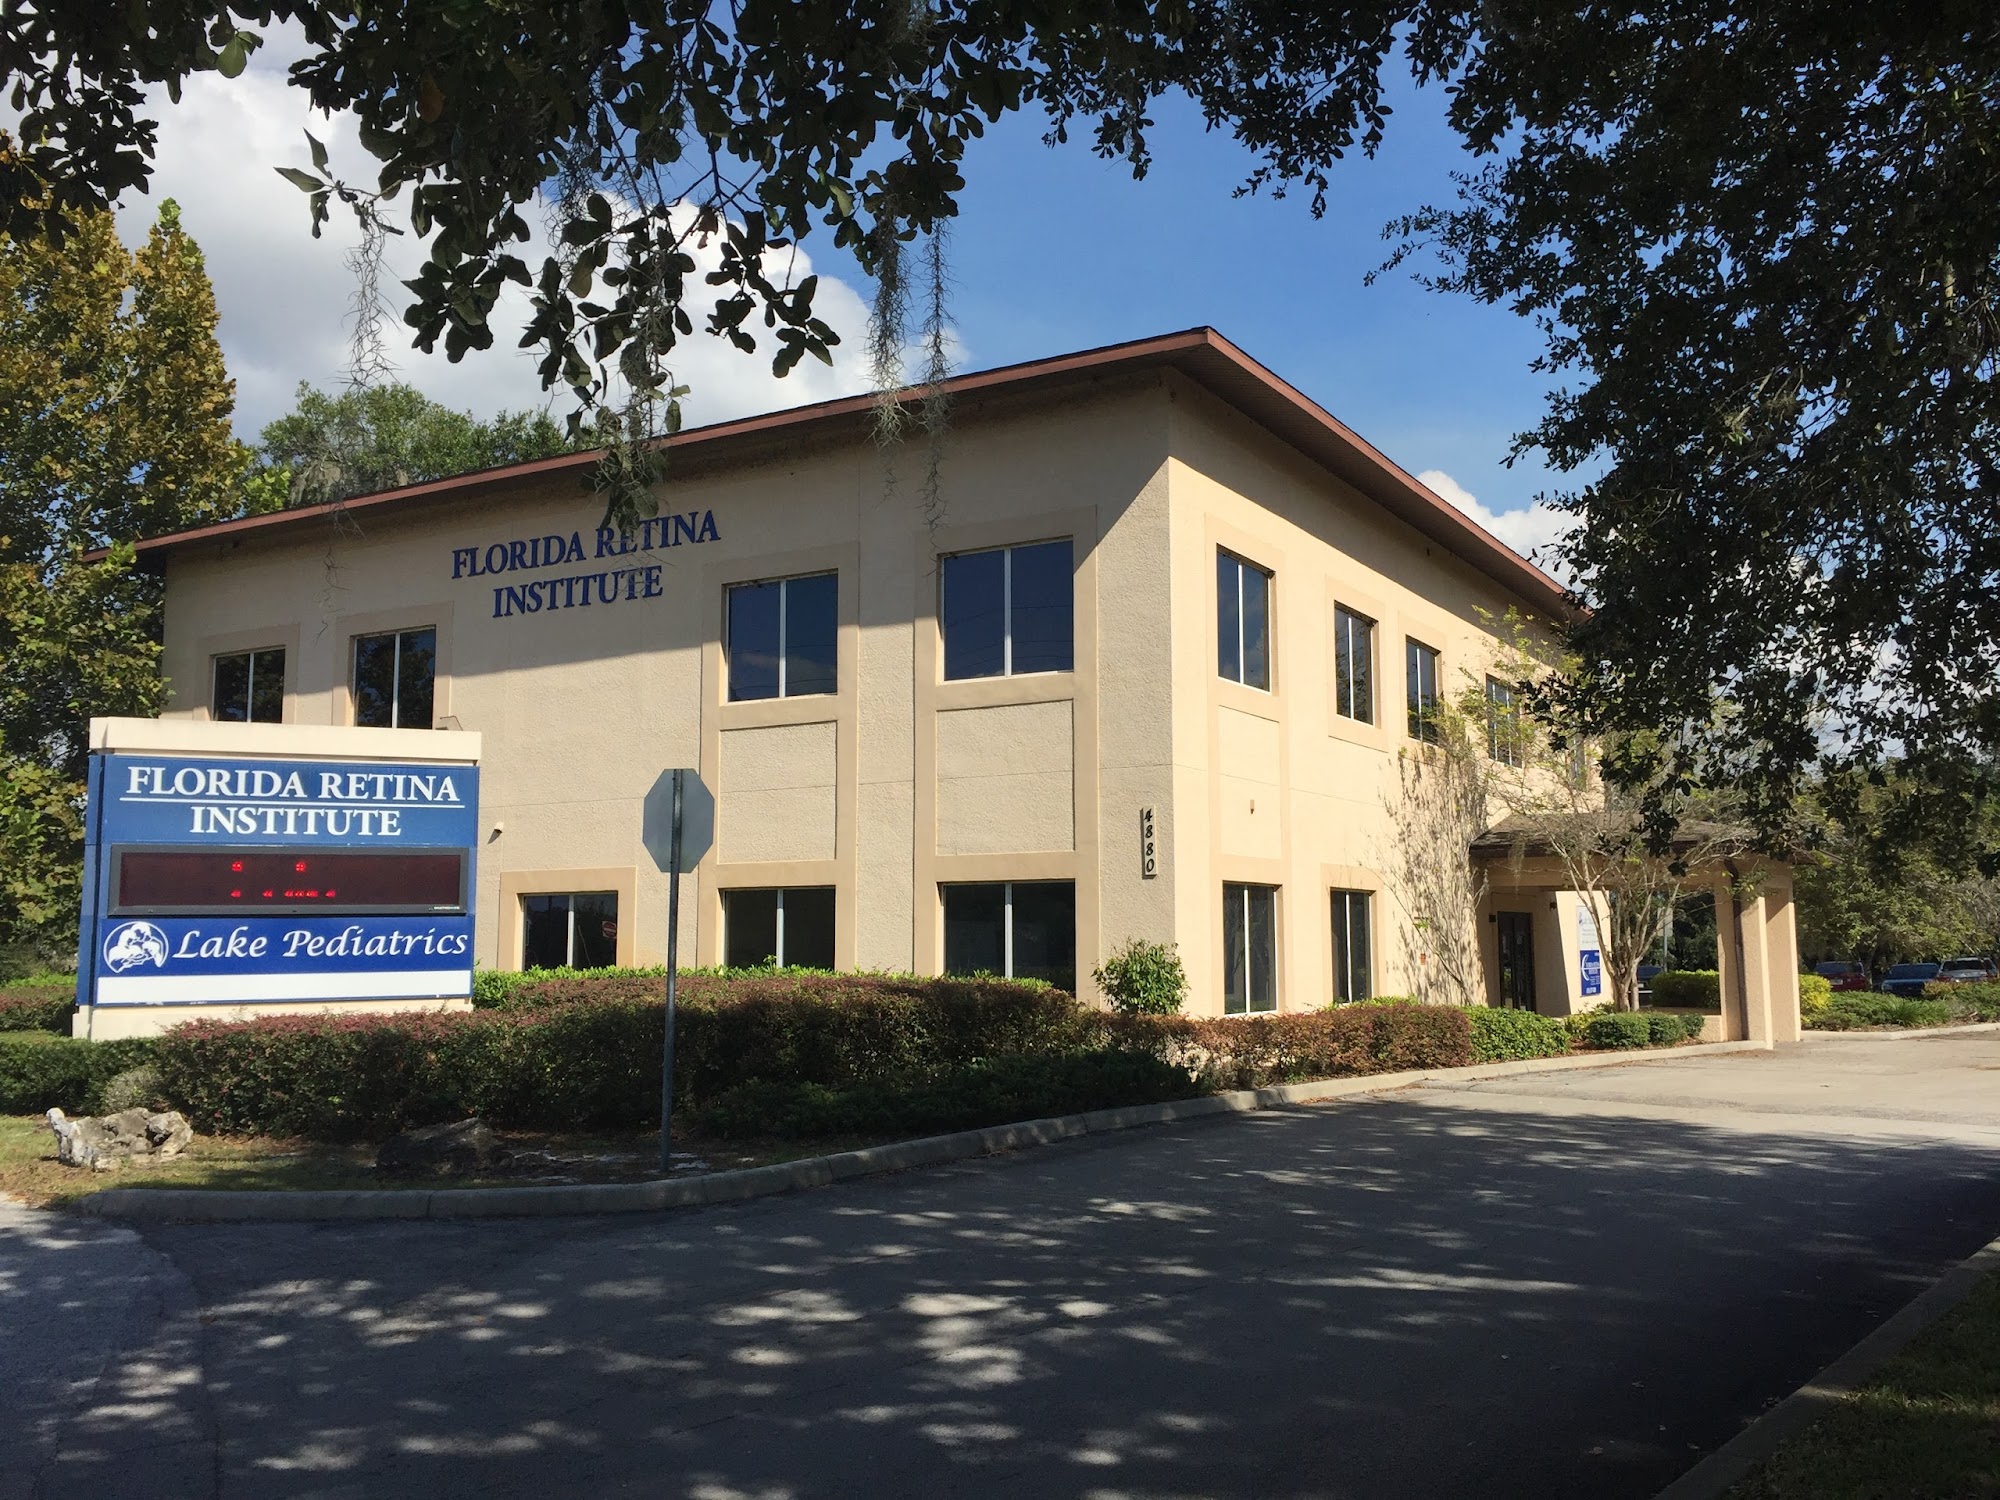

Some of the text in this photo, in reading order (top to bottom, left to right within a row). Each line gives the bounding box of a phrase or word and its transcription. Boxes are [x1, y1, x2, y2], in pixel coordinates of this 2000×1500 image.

[451, 510, 721, 579] FLORIDA RETINA
[492, 565, 663, 618] INSTITUTE
[126, 766, 460, 801] FLORIDA RETINA
[190, 806, 401, 836] INSTITUTE
[1144, 808, 1155, 873] 4880
[173, 925, 468, 958] Lake Pediatrics
